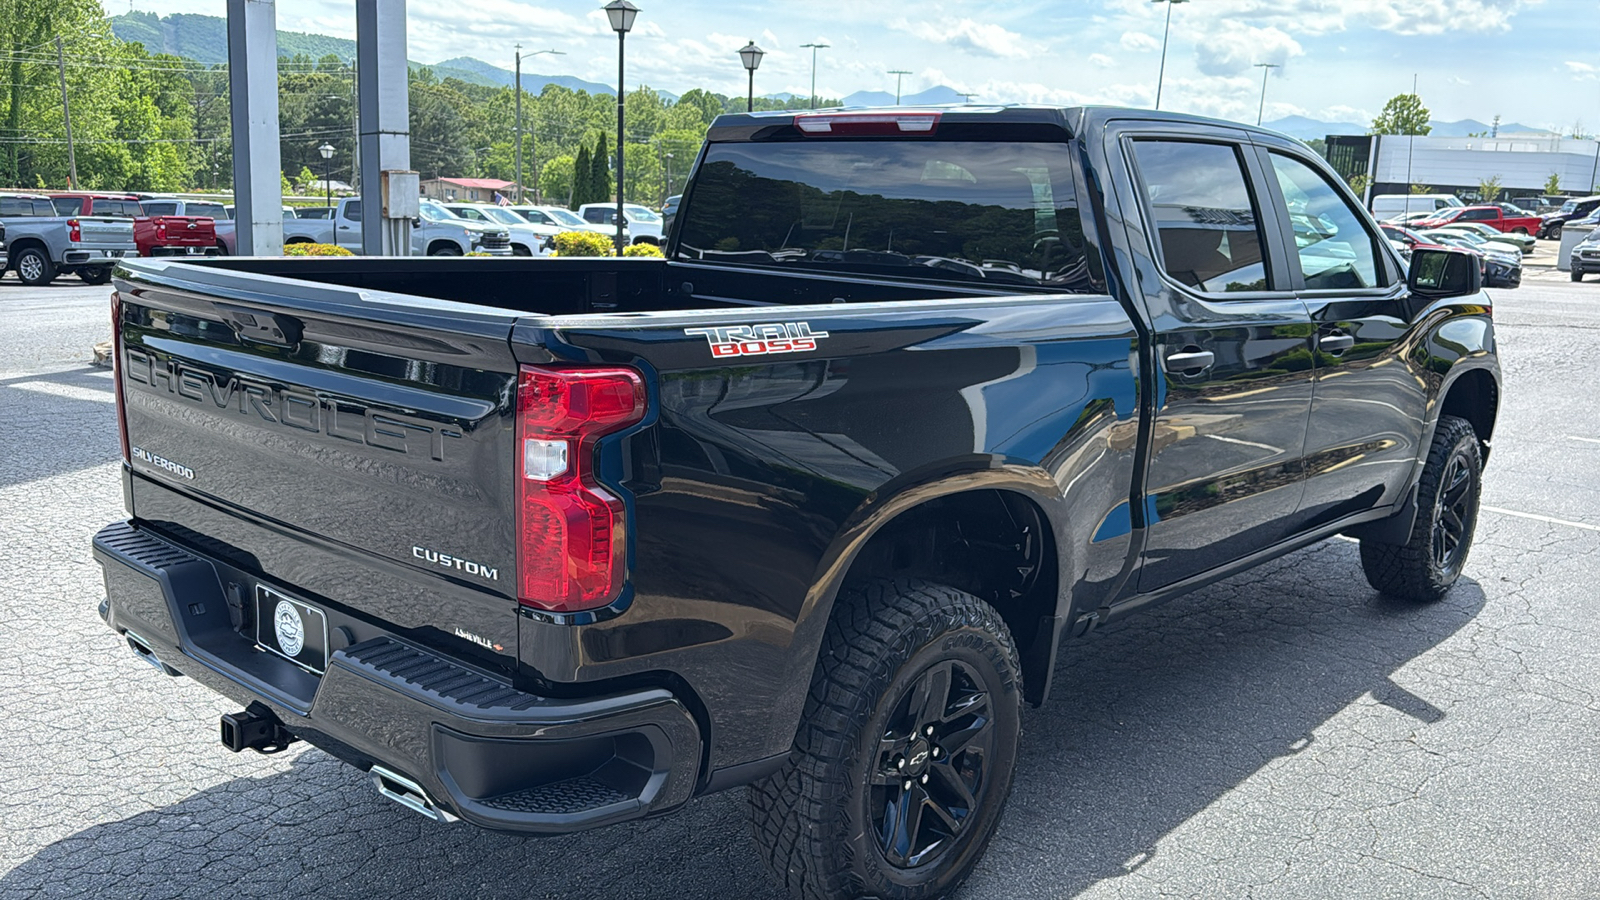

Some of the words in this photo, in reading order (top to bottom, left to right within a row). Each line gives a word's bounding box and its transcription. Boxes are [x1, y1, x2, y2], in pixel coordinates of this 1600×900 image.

[684, 322, 829, 344] TRAIL
[711, 338, 817, 358] BOSS
[127, 349, 463, 461] CHEVROLET
[132, 446, 195, 480] SILVERADO
[412, 546, 498, 580] CUSTOM
[455, 627, 493, 649] ASHEVILLE
